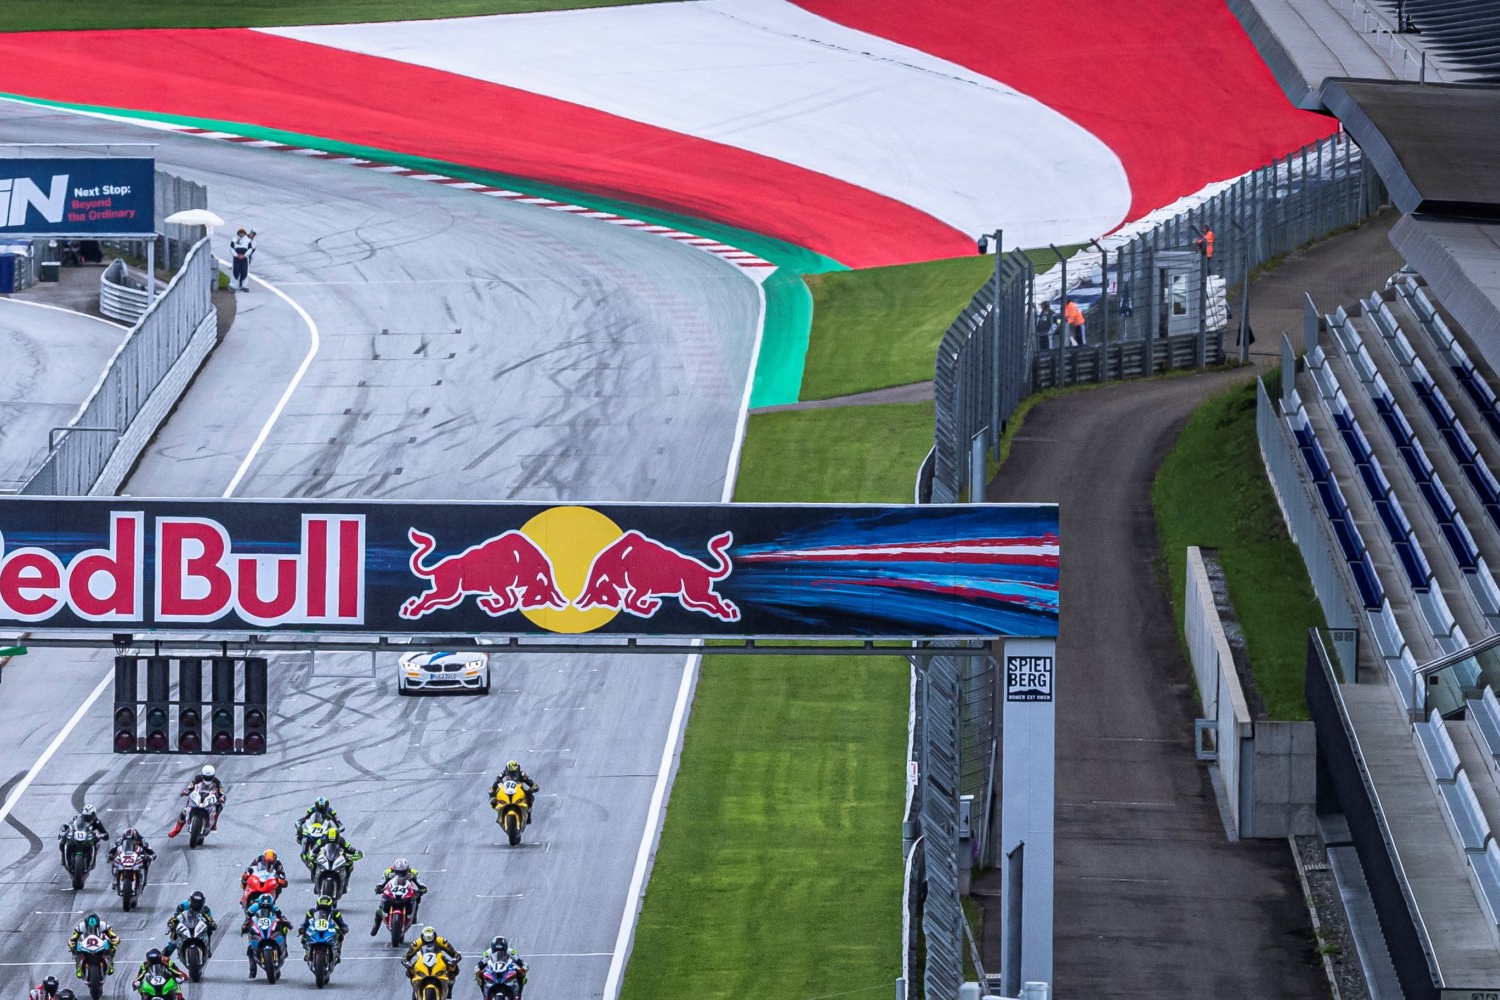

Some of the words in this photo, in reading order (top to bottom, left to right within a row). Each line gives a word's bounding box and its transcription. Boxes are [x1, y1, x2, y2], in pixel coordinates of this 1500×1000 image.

[74, 187, 100, 198] Next
[103, 185, 131, 196] Stop:
[71, 198, 112, 210] Beyond
[68, 212, 86, 222] the
[89, 209, 136, 221] Ordinary
[155, 514, 366, 627] Bull
[1009, 658, 1051, 673] SPIEL
[1009, 673, 1047, 688] BERG
[495, 962, 505, 971] 17
